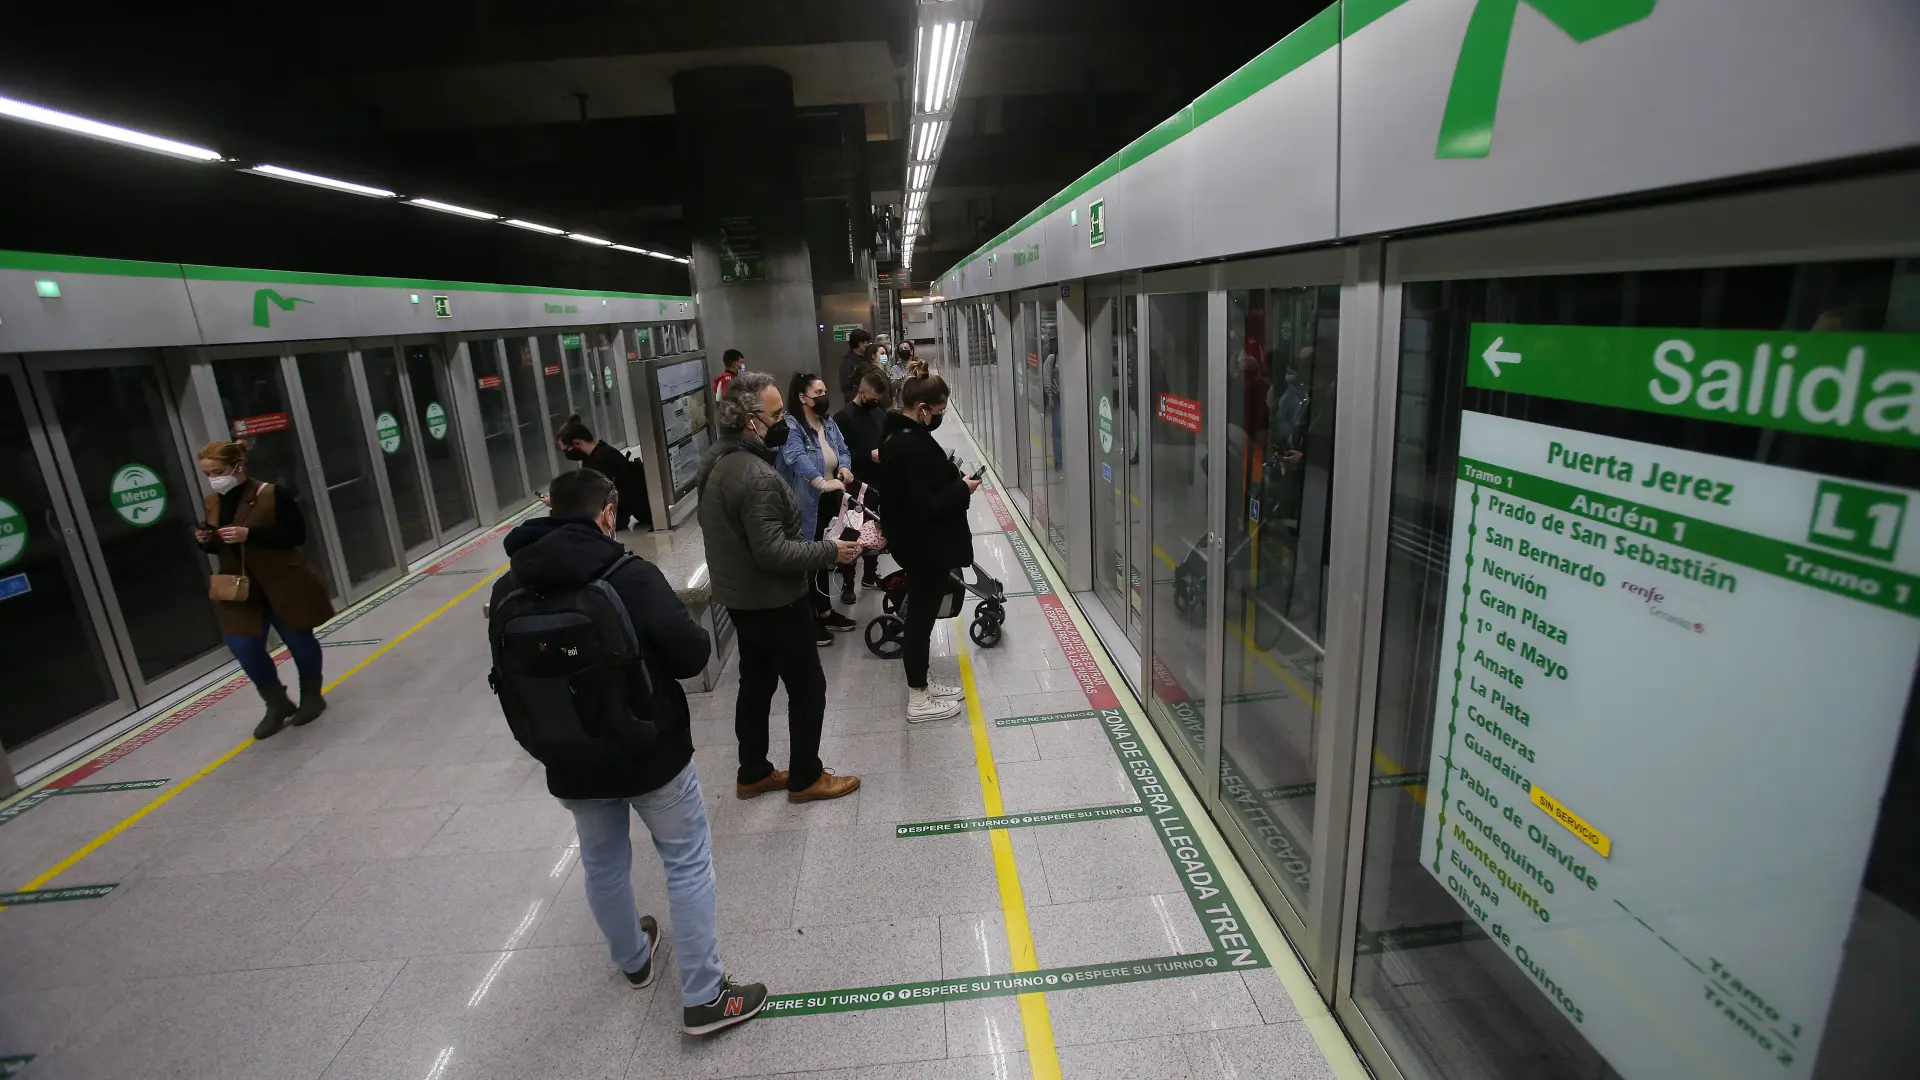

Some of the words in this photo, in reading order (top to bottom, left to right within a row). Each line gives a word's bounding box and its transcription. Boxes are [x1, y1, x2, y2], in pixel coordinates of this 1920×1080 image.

[1648, 339, 1920, 435] Salida
[120, 488, 157, 504] Metro
[1464, 464, 1502, 485] Tramo
[1507, 476, 1514, 489] 1
[1547, 441, 1635, 483] Puerta
[1641, 461, 1735, 506] Jerez
[1570, 494, 1659, 534] Andén
[1672, 521, 1687, 542] 1
[1486, 526, 1514, 551] San
[1519, 538, 1606, 587] Bernardo
[1488, 495, 1536, 525] Prado
[1542, 514, 1565, 535] de
[1570, 521, 1608, 549] San
[1614, 535, 1738, 593] Sebastián
[1482, 557, 1547, 600] Nervión
[1621, 581, 1665, 603] renfe
[1784, 554, 1882, 595] Tramo
[1894, 583, 1911, 604] 1
[1056, 630, 1074, 650] FRENTE
[1480, 588, 1517, 620] Gran
[1521, 608, 1569, 645] Plaza
[1069, 655, 1083, 666] LAS
[1070, 635, 1088, 652] ANTES
[1084, 657, 1106, 685] ENTRAR
[1074, 664, 1097, 693] PUERTAS
[1474, 649, 1524, 689] Amate
[1496, 631, 1516, 651] de
[1520, 641, 1569, 680] Mayo
[1101, 709, 1132, 740] ZONA
[1470, 676, 1486, 698] La
[1491, 689, 1530, 727] Plata
[1119, 741, 1143, 758] DE
[1467, 705, 1536, 763] Cocheras
[1129, 760, 1173, 814] ESPERA
[1464, 733, 1531, 794] Guadaíra
[908, 824, 951, 833] ESPERE
[971, 819, 1009, 828] TURNO
[1033, 813, 1076, 822] ESPERE
[1094, 807, 1132, 816] TURNO
[1459, 766, 1498, 808] Pablo
[1503, 806, 1523, 829] de
[1527, 824, 1599, 892] Olavide
[1540, 795, 1553, 812] SIN
[1556, 808, 1599, 844] SERVICIO
[1159, 817, 1219, 900] LLEGADA
[1456, 799, 1555, 895] Condequinto
[1450, 849, 1500, 906] Europa
[1453, 824, 1550, 923] Montequinto
[1205, 902, 1258, 966] TREN
[1447, 875, 1488, 922] Olivar
[1492, 923, 1511, 947] de
[1515, 945, 1584, 1023] Quintos
[723, 996, 743, 1016] N
[807, 997, 826, 1008] SU
[831, 992, 880, 1006] TURNO
[912, 983, 968, 998] ESPERE
[971, 981, 990, 992] SU
[994, 975, 1044, 988] TURNO
[1075, 966, 1129, 981] ESPERE
[1133, 964, 1152, 975] SU
[1154, 958, 1204, 972] TURNO
[1708, 957, 1781, 1021] Tramo
[1791, 1022, 1802, 1039] 1
[1704, 984, 1773, 1051] Tramo
